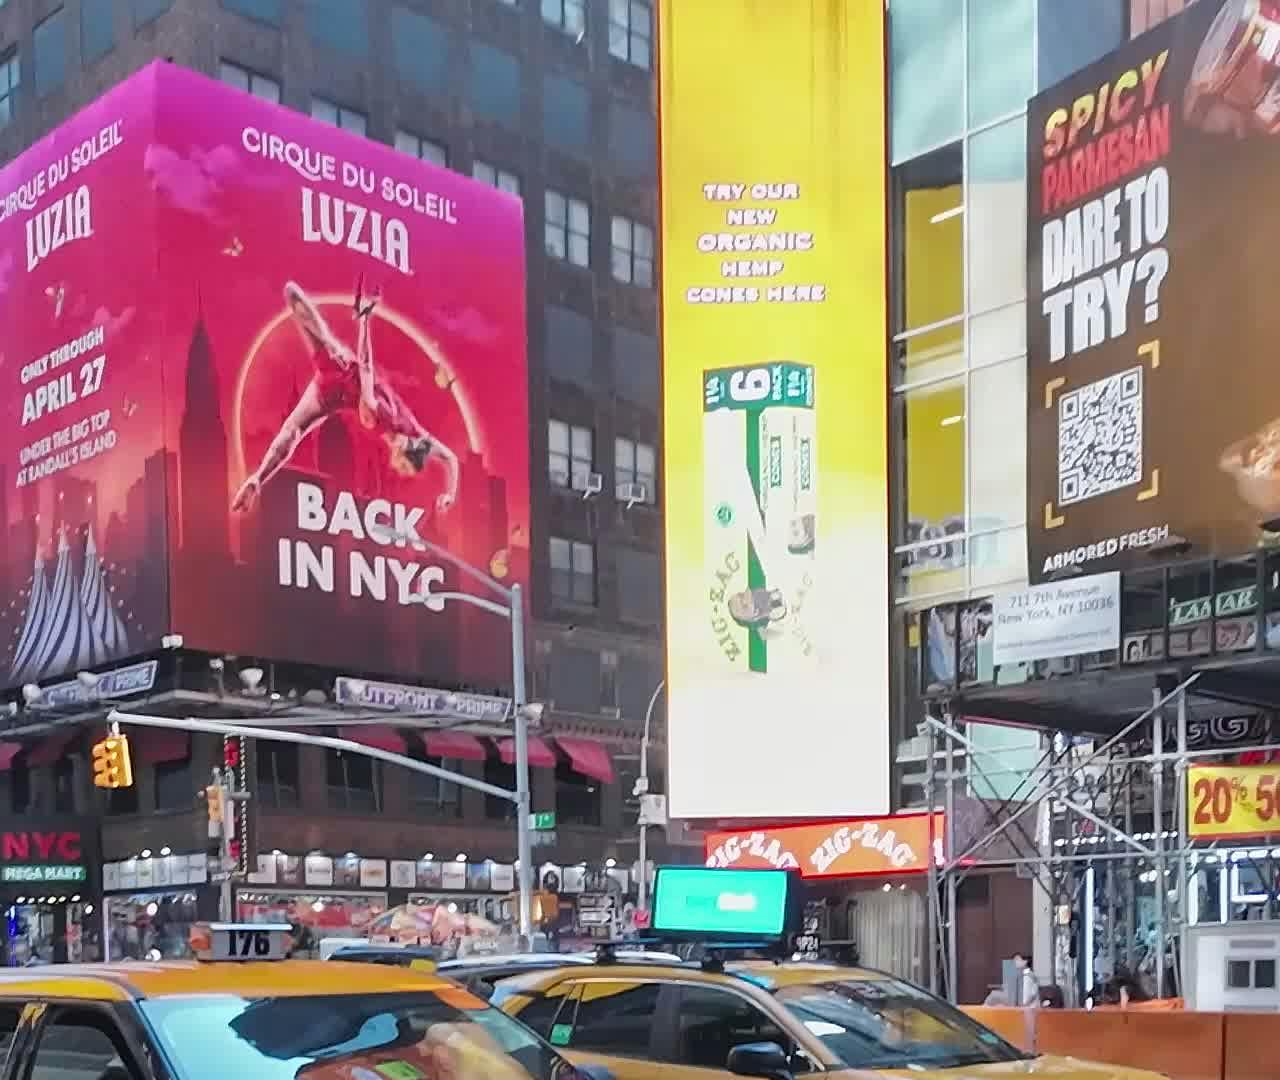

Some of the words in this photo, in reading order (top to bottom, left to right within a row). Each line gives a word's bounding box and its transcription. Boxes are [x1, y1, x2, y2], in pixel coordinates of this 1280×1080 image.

[1043, 48, 1169, 158] SPICY
[47, 154, 69, 188] DU
[70, 119, 123, 174] SOLEIL
[242, 126, 337, 182] CIRQUE
[342, 161, 375, 194] DU
[381, 176, 458, 224] SOLEIL
[1041, 103, 1169, 214] PARMESAN
[704, 183, 744, 201] TRY
[751, 183, 800, 200] OUR
[726, 208, 777, 226] NEW
[25, 184, 94, 273] LUZIA
[301, 187, 412, 274] LUZIA
[697, 232, 814, 252] ORGANIC
[1042, 187, 1122, 293] DARE
[1125, 165, 1169, 253] TO
[686, 286, 760, 303] COMES
[768, 283, 827, 303] HERE
[721, 260, 784, 278] HEMP
[1042, 247, 1169, 363] TRY?
[21, 354, 49, 384] ONLY
[49, 325, 105, 369] THROUGH
[21, 371, 77, 427] APRIL
[79, 354, 107, 398] 27
[730, 368, 770, 402] 6
[16, 464, 28, 489] AT
[28, 445, 79, 482] RANDALL'S
[79, 429, 117, 462] ISLAND
[20, 436, 51, 466] UNDER
[52, 427, 70, 449] THE
[71, 418, 90, 443] BIG
[91, 408, 111, 433] TOP
[297, 482, 426, 552] BACK
[278, 537, 334, 593] IN
[349, 551, 445, 612] NYC
[1042, 537, 1118, 574] ARMORED
[1120, 523, 1169, 552] FRESH
[344, 680, 440, 712] UTFRONT
[1192, 774, 1249, 825] 20%
[2, 831, 81, 861] NYC
[4, 865, 42, 881] MEGA
[44, 866, 83, 881] MART
[810, 822, 919, 873] ZIG-ZAG
[228, 930, 270, 956] 176
